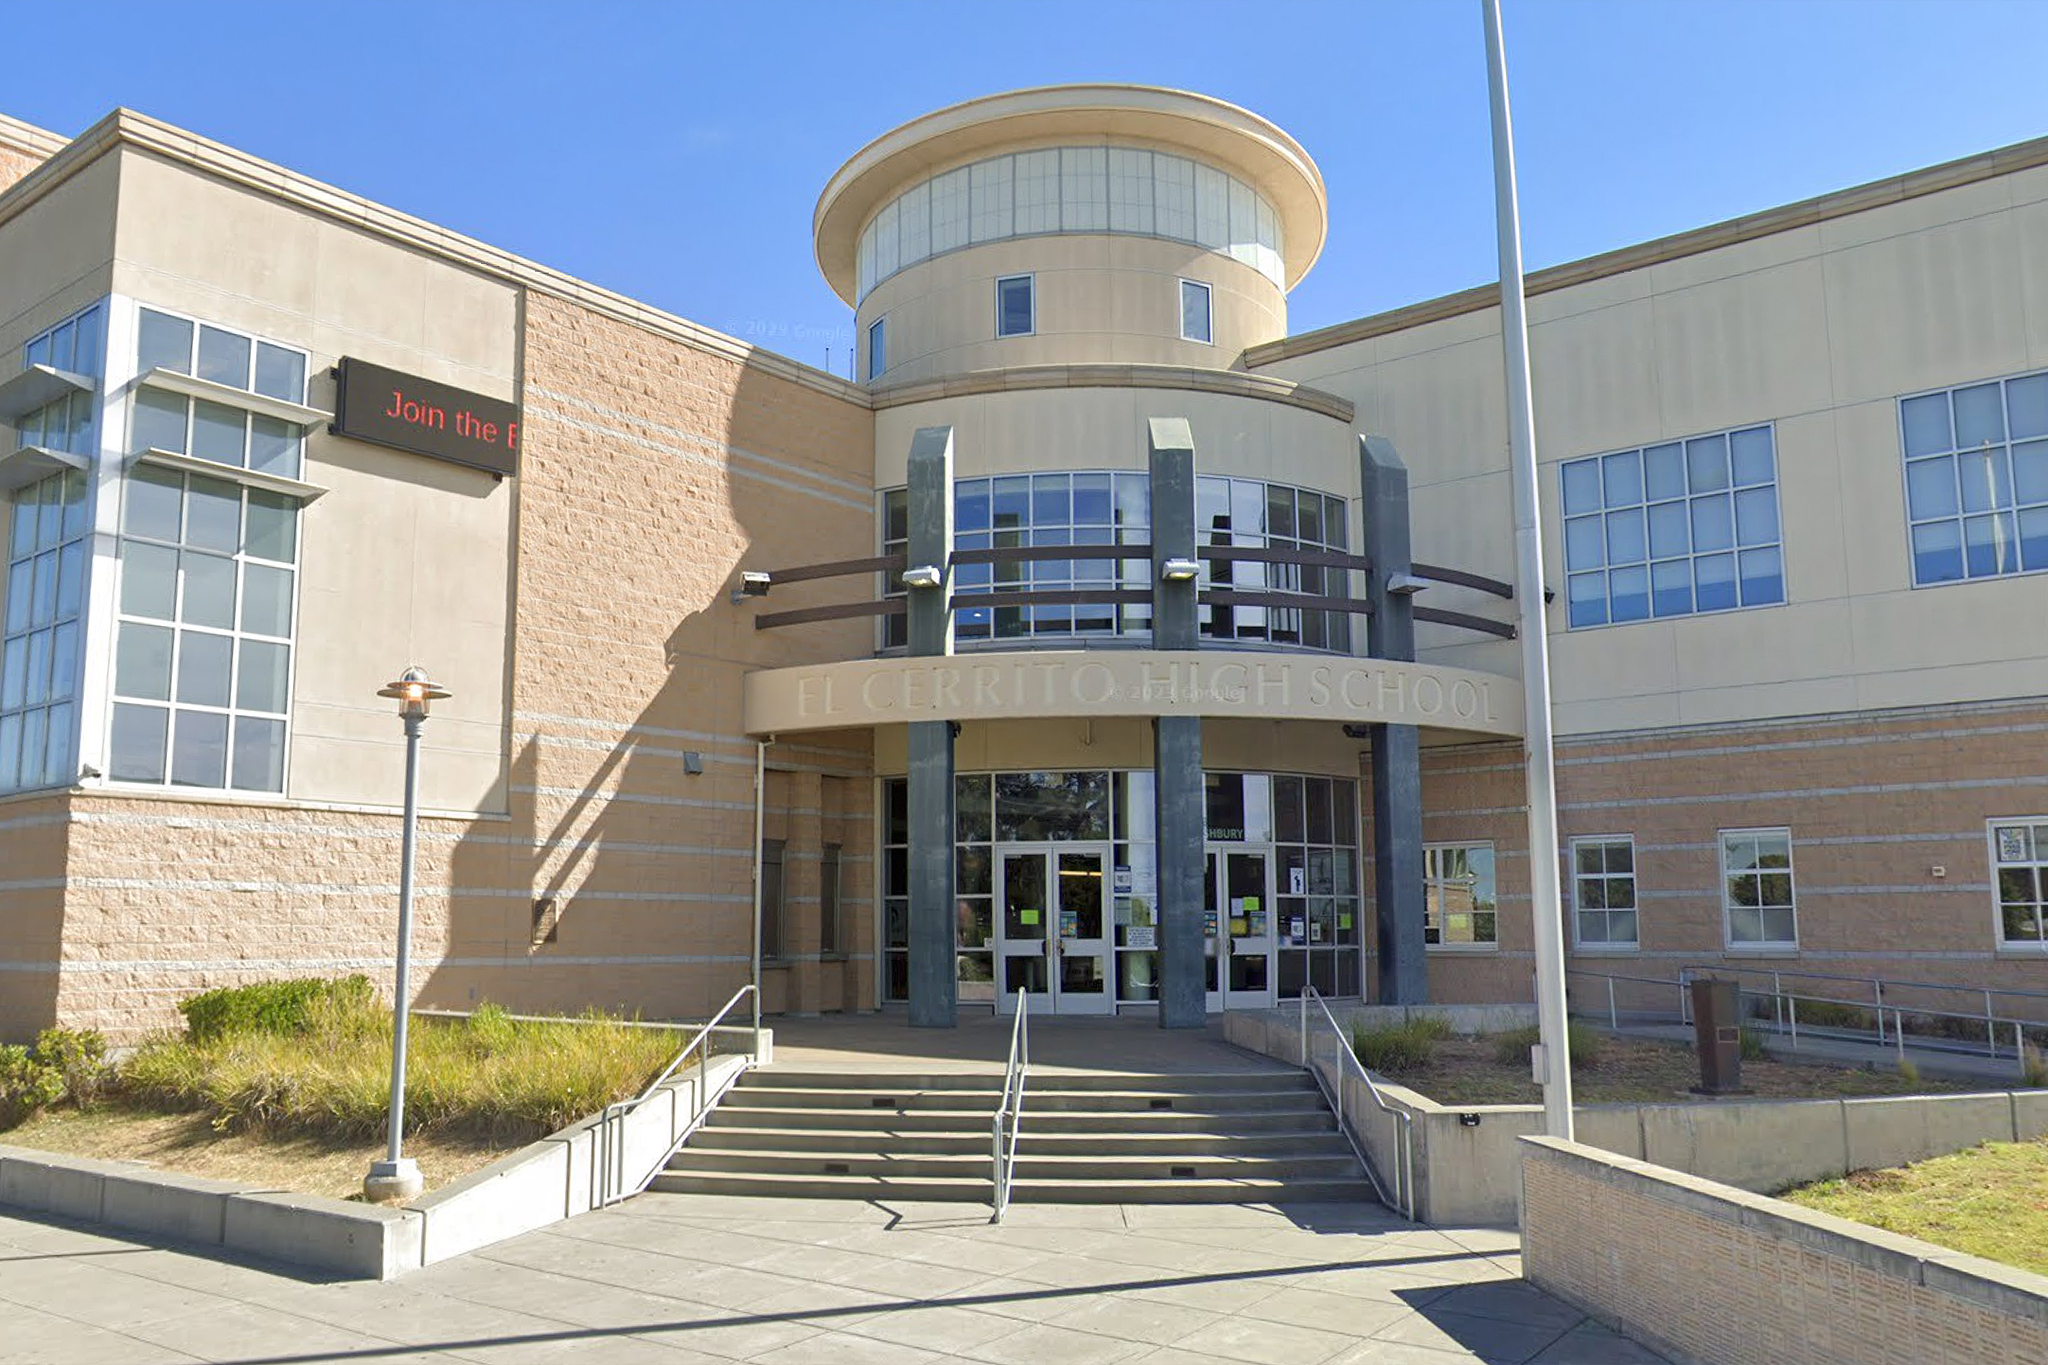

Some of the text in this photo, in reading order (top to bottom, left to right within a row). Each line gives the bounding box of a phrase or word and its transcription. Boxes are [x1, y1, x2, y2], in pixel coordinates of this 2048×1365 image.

[385, 390, 446, 430] Join
[455, 410, 499, 443] the
[797, 660, 1499, 723] EL CERRITO HIGH SCHOOL
